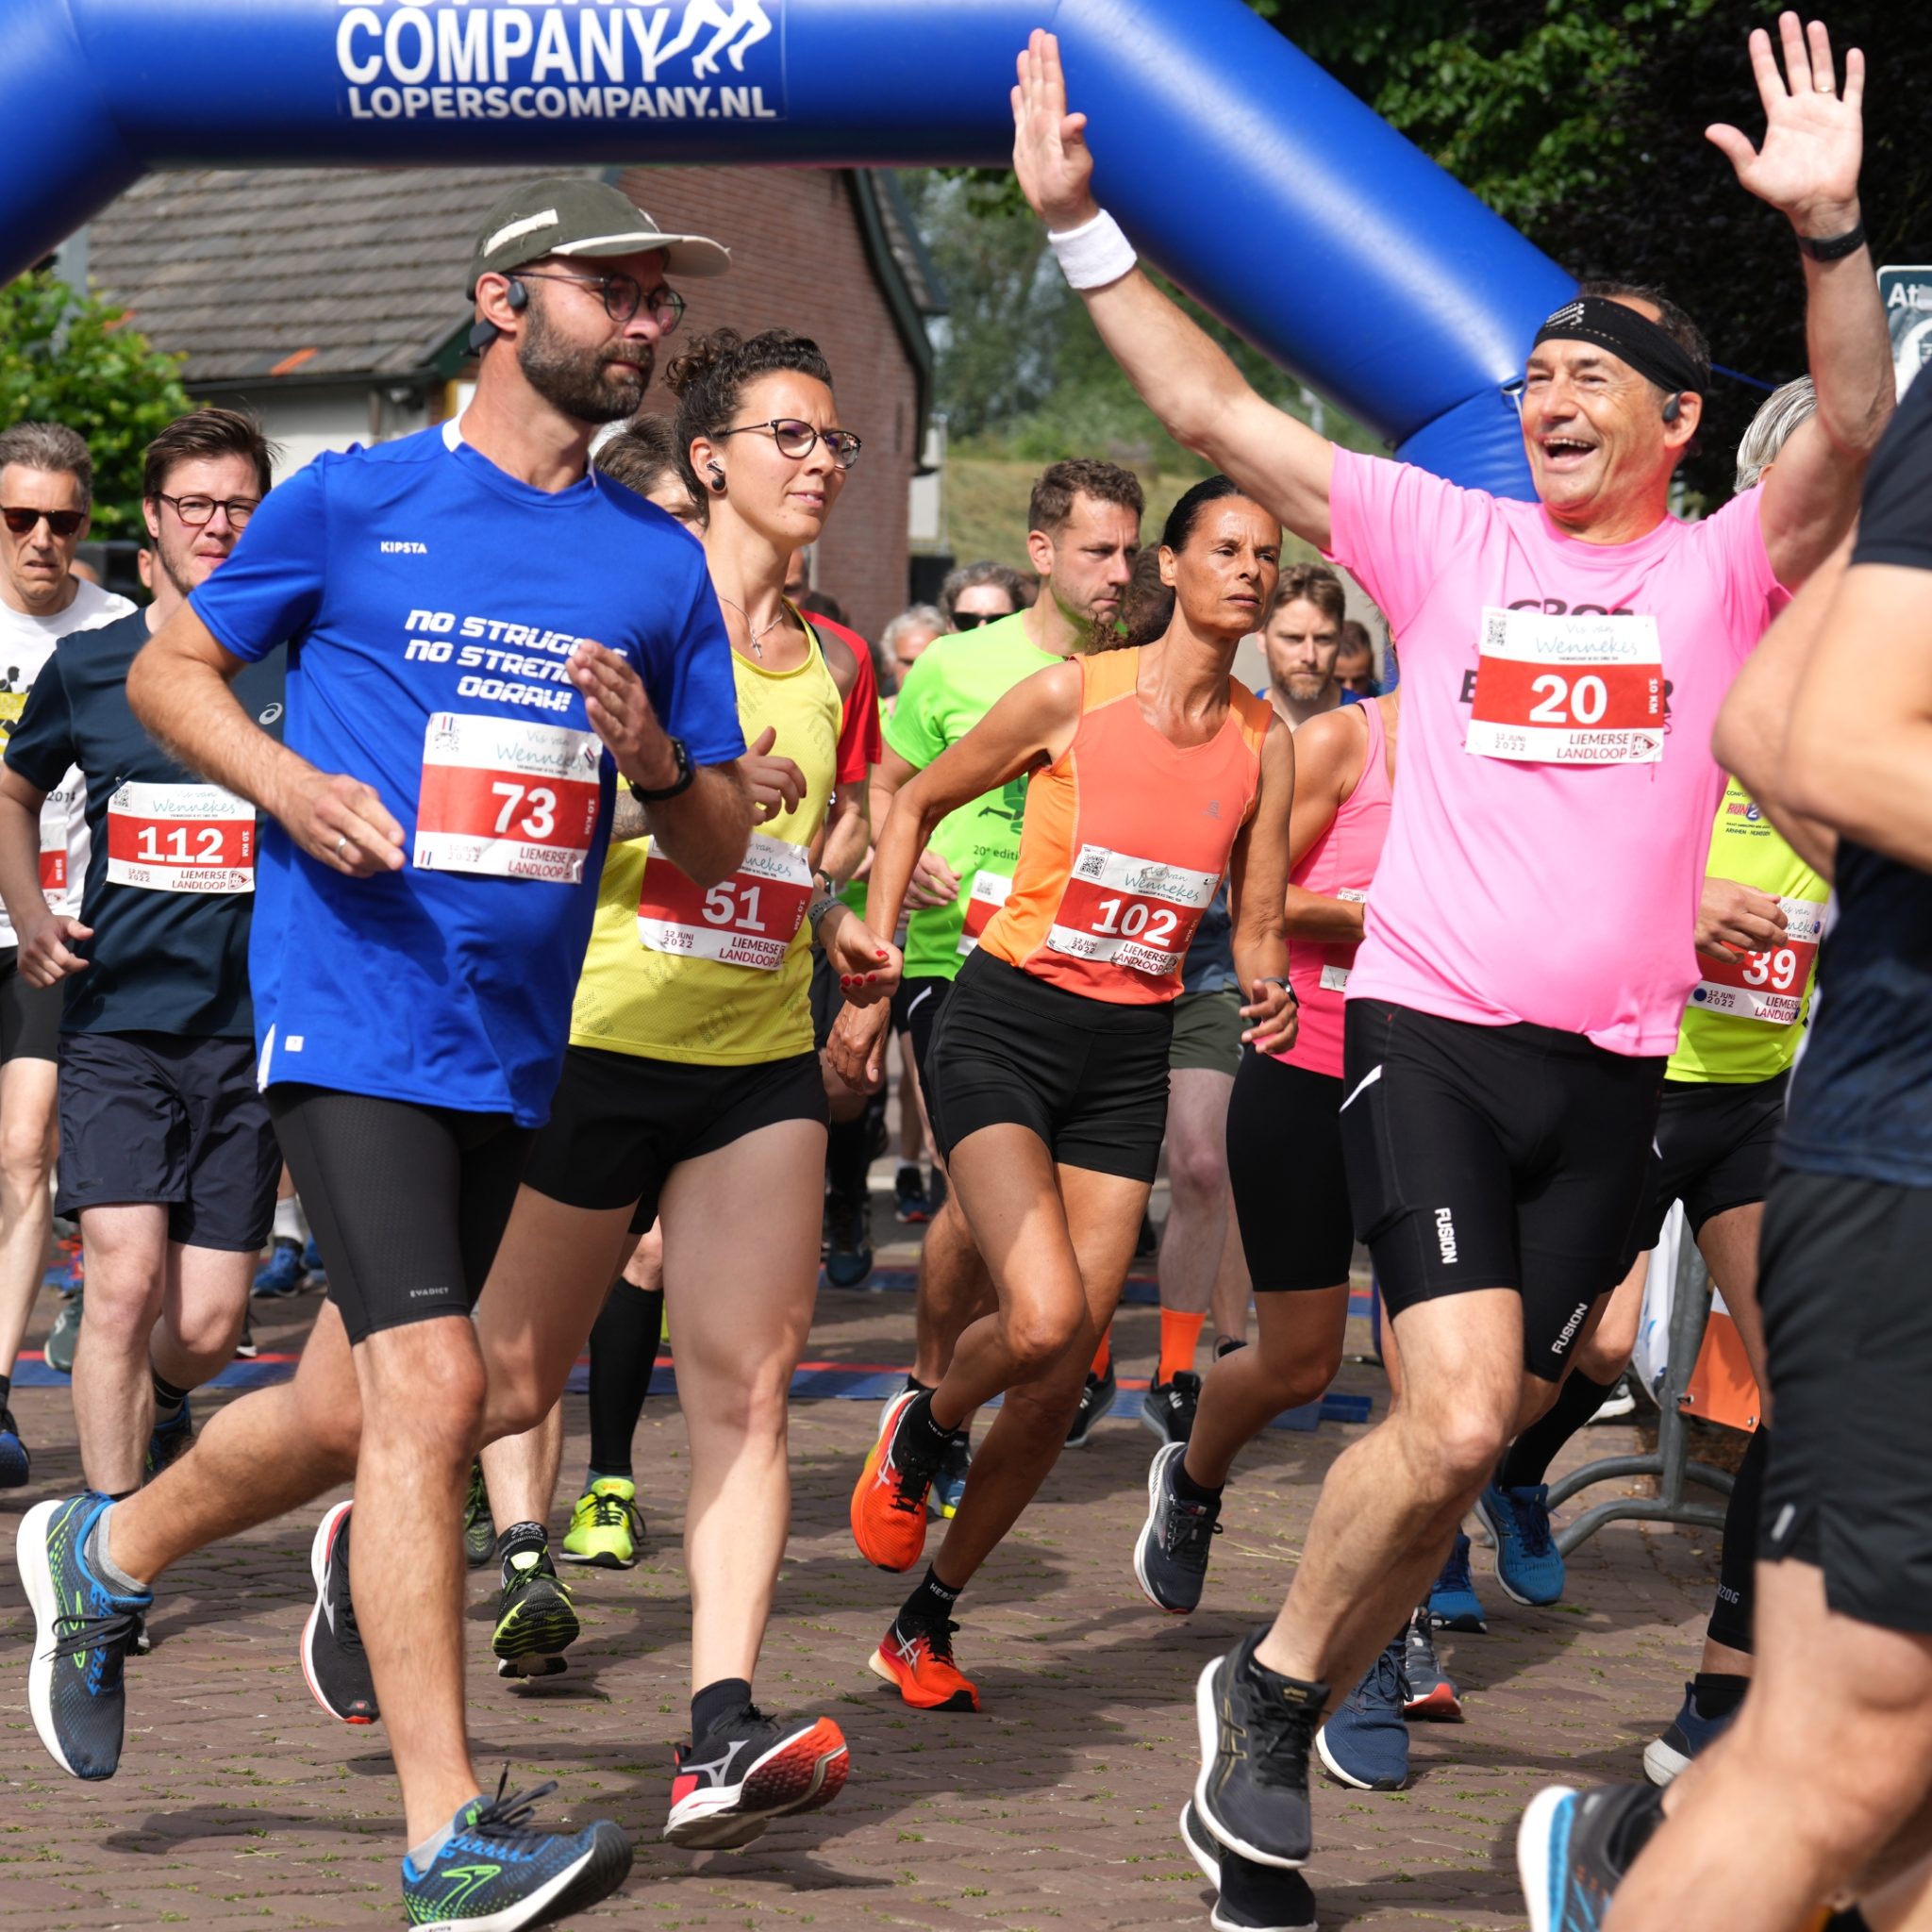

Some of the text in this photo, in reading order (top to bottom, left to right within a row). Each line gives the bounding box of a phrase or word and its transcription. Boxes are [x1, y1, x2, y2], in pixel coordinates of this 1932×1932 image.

[336, 8, 670, 84] COMPANY
[348, 86, 776, 119] LOPERSCOMPANY.NL
[380, 541, 427, 554] KIPSTA
[405, 609, 456, 633] NO
[405, 640, 454, 662] NO
[1536, 636, 1639, 656] Wennekes
[1528, 674, 1607, 724] 20
[1570, 733, 1630, 745] LIEMERSE
[1557, 746, 1628, 759] LANDLOOP
[153, 799, 236, 814] Wennekes
[491, 781, 557, 839] 73
[137, 825, 224, 864] 112
[520, 847, 566, 863] LIEMERSE
[993, 848, 1019, 861] editi
[180, 870, 227, 879] LIEMERSE
[508, 860, 564, 877] LANDLOOP
[172, 880, 226, 890] LANDLOOP
[1124, 873, 1199, 902] Wennekes
[702, 881, 765, 932] 51
[1091, 899, 1178, 947] 102
[663, 938, 693, 949] 2022
[731, 937, 779, 956] LIEMERSE
[1071, 943, 1095, 955] 2022
[1123, 943, 1168, 963] LIEMERSE
[719, 948, 775, 967] LANDLOOP
[1742, 949, 1796, 990] 39
[1707, 996, 1735, 1008] 2022
[1721, 992, 1736, 1001] JUNI
[1435, 1208, 1457, 1264] FUSION
[409, 1287, 449, 1298] EVADICT
[1551, 1303, 1588, 1355] FUSION
